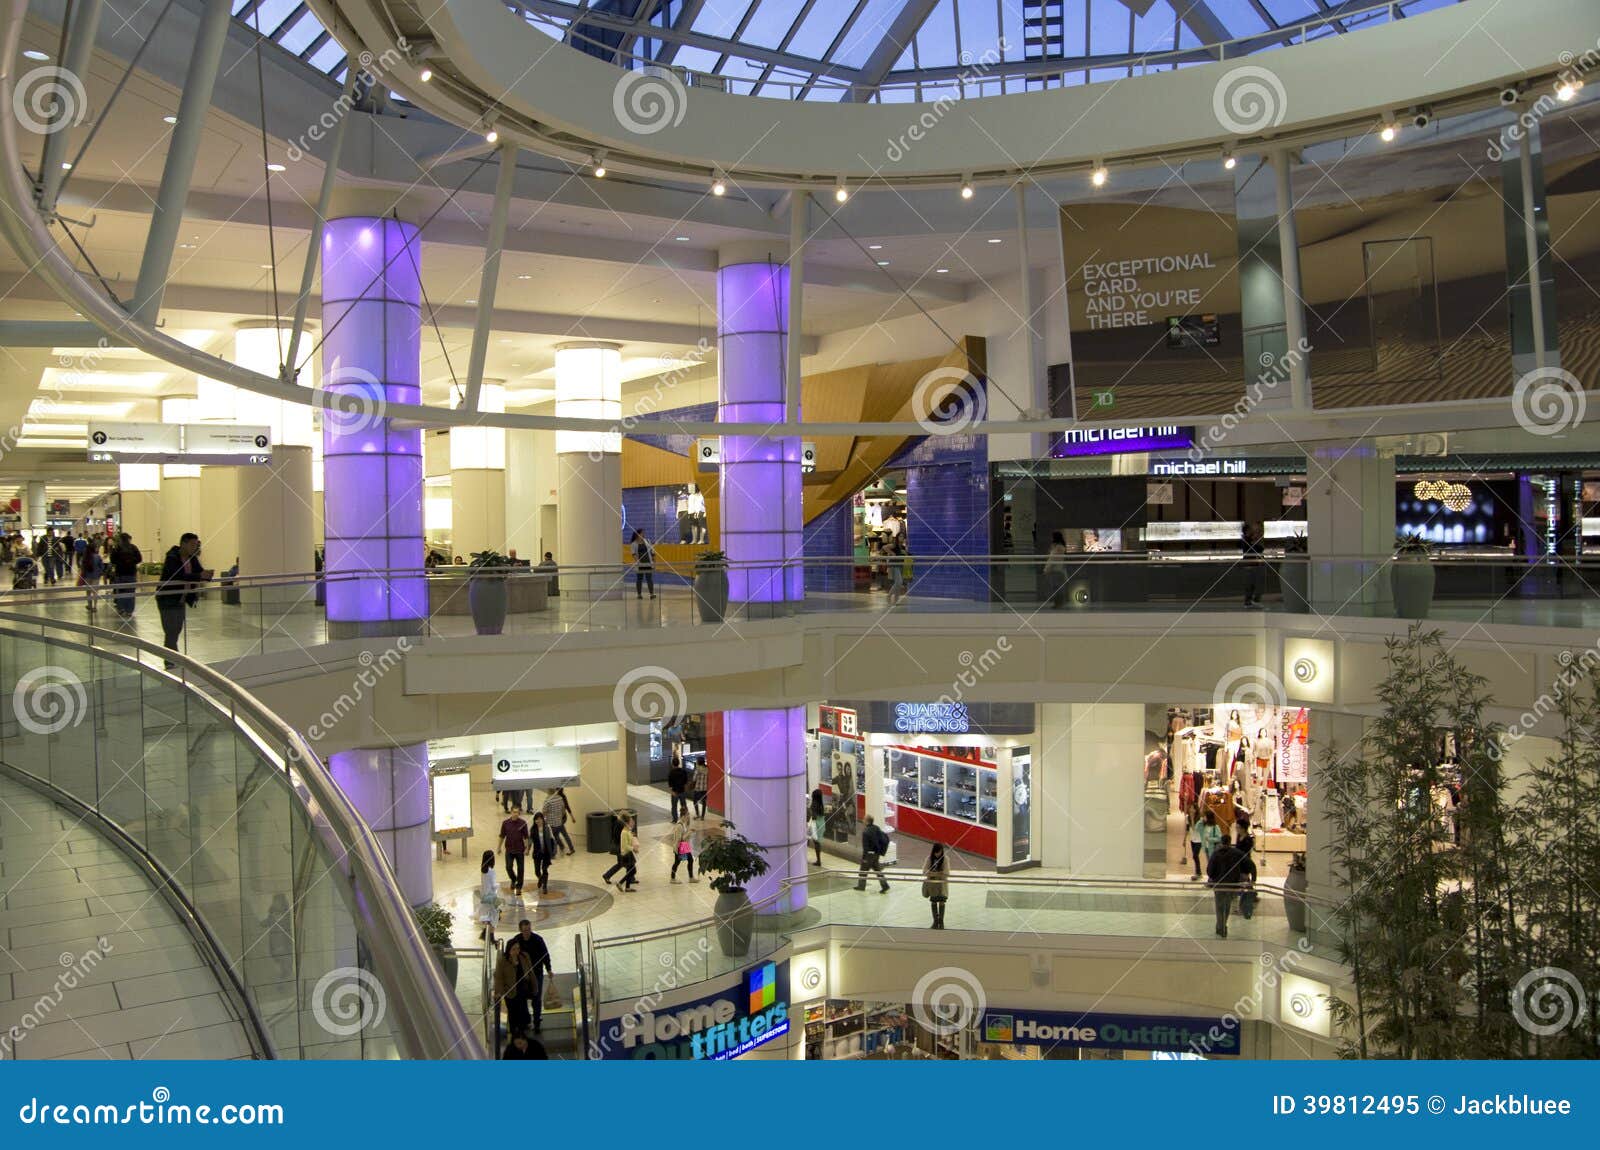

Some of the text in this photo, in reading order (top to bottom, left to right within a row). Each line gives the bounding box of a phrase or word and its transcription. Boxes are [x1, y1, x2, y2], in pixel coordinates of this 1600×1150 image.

[1083, 253, 1216, 280] EXCEPTIONAL
[1084, 278, 1142, 297] CARD.
[1086, 288, 1201, 314] AND YOU'RE
[1086, 311, 1153, 330] THERE.
[1094, 392, 1113, 406] TD
[1154, 460, 1246, 474] michael hill
[895, 702, 955, 718] QUARTZ
[895, 717, 969, 733] CHRONOS
[622, 999, 736, 1049] Home
[1016, 1020, 1097, 1042] Home
